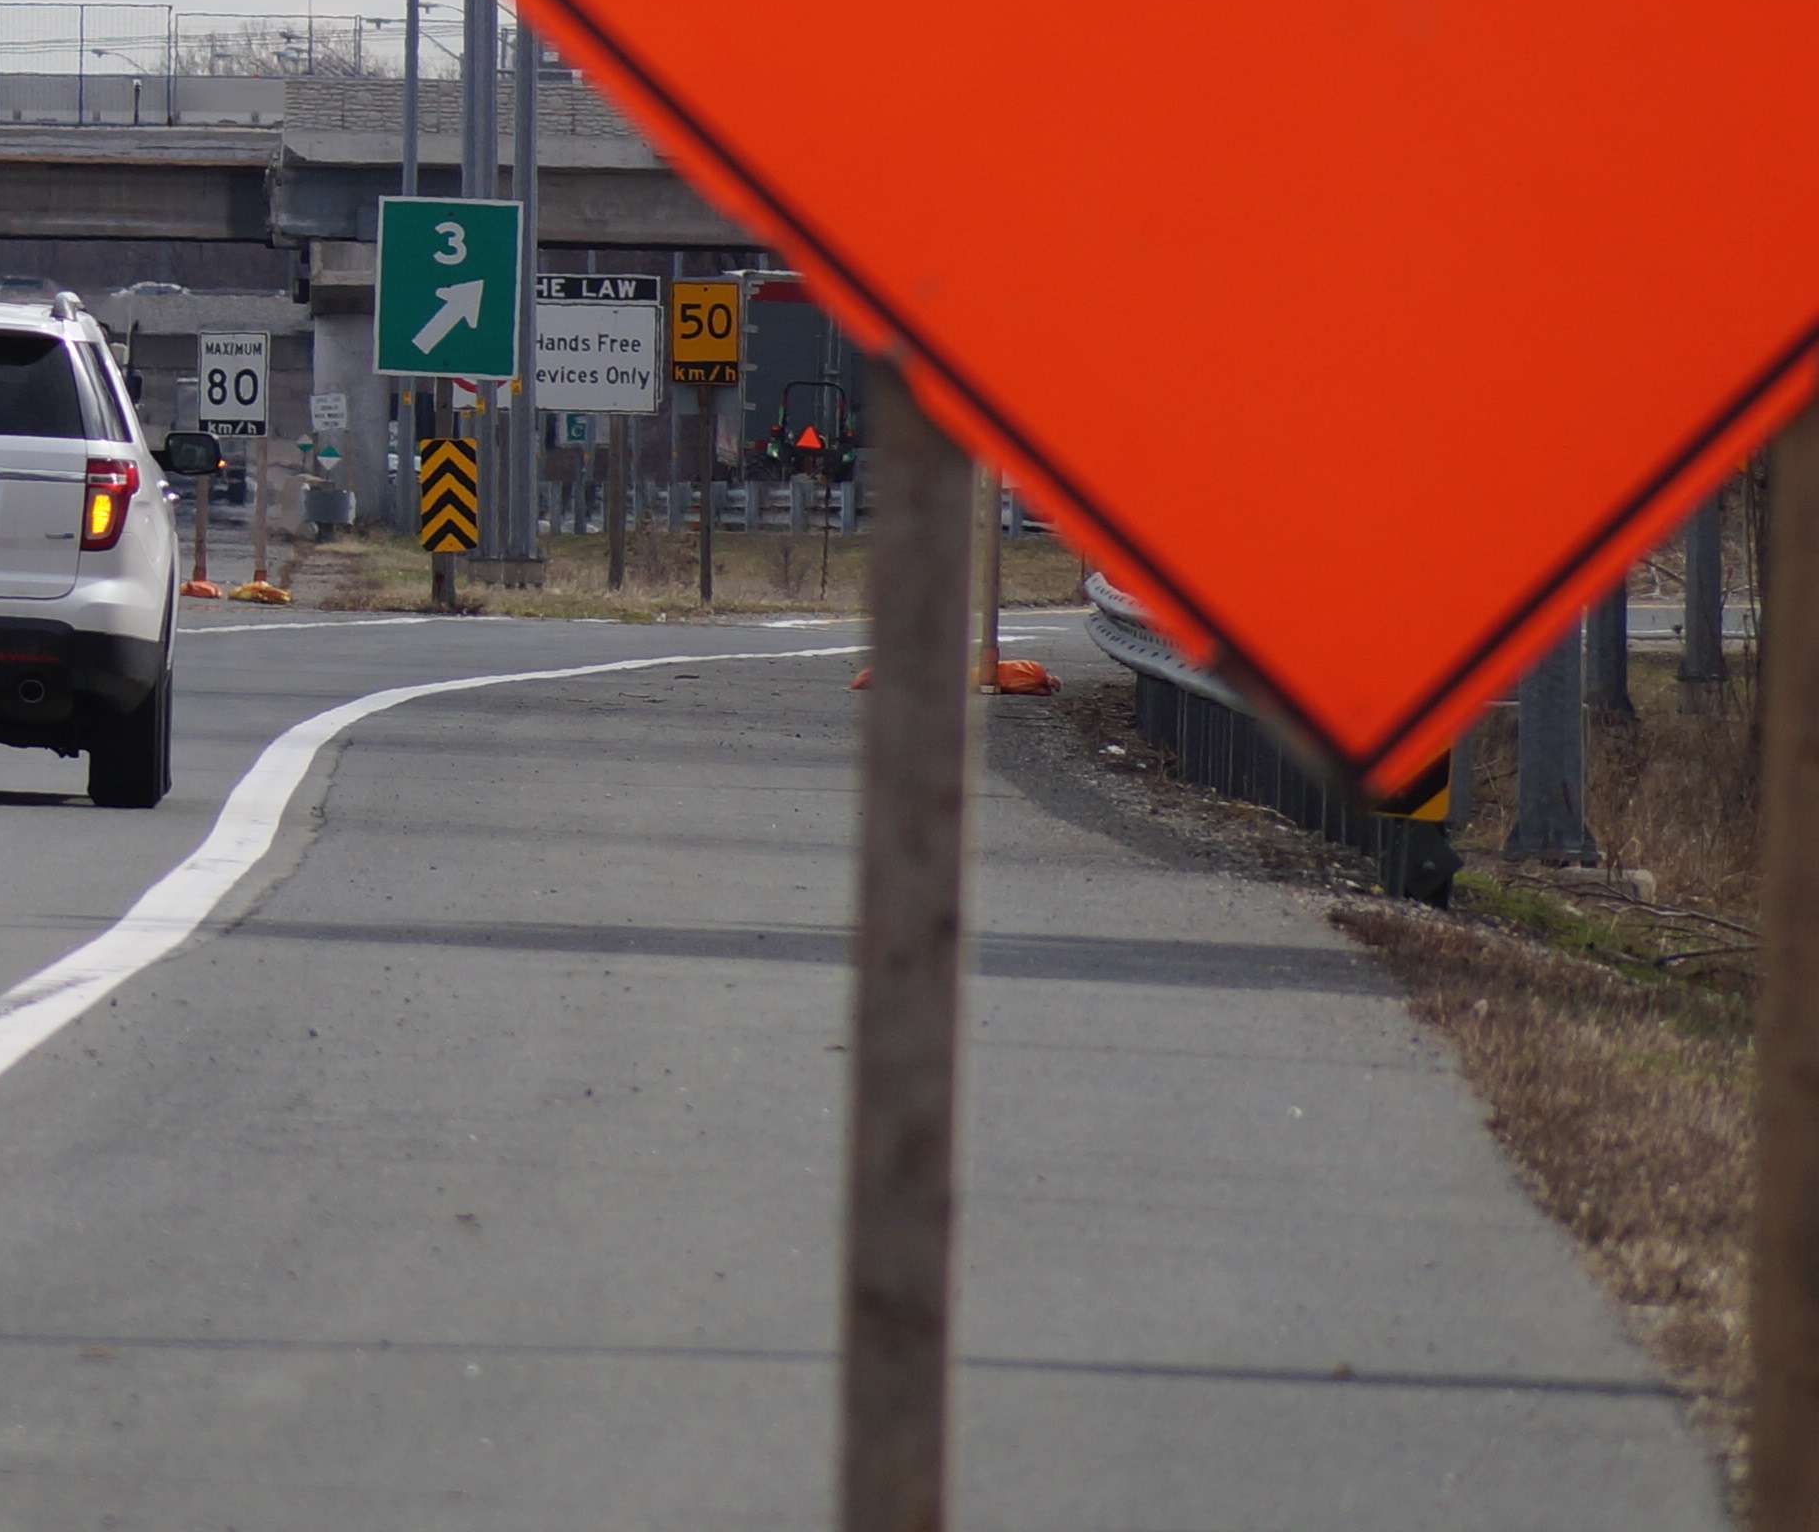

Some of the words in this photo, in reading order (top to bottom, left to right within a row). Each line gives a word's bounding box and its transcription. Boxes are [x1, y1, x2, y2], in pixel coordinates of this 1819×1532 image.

[433, 221, 468, 265] 3
[582, 279, 637, 299] LAW
[680, 303, 733, 340] 50
[205, 341, 263, 357] MAXIMUM
[598, 333, 642, 353] Free
[606, 366, 651, 390] Only
[674, 366, 737, 382] km/h
[208, 368, 259, 406] 80
[208, 420, 257, 435] km/h
